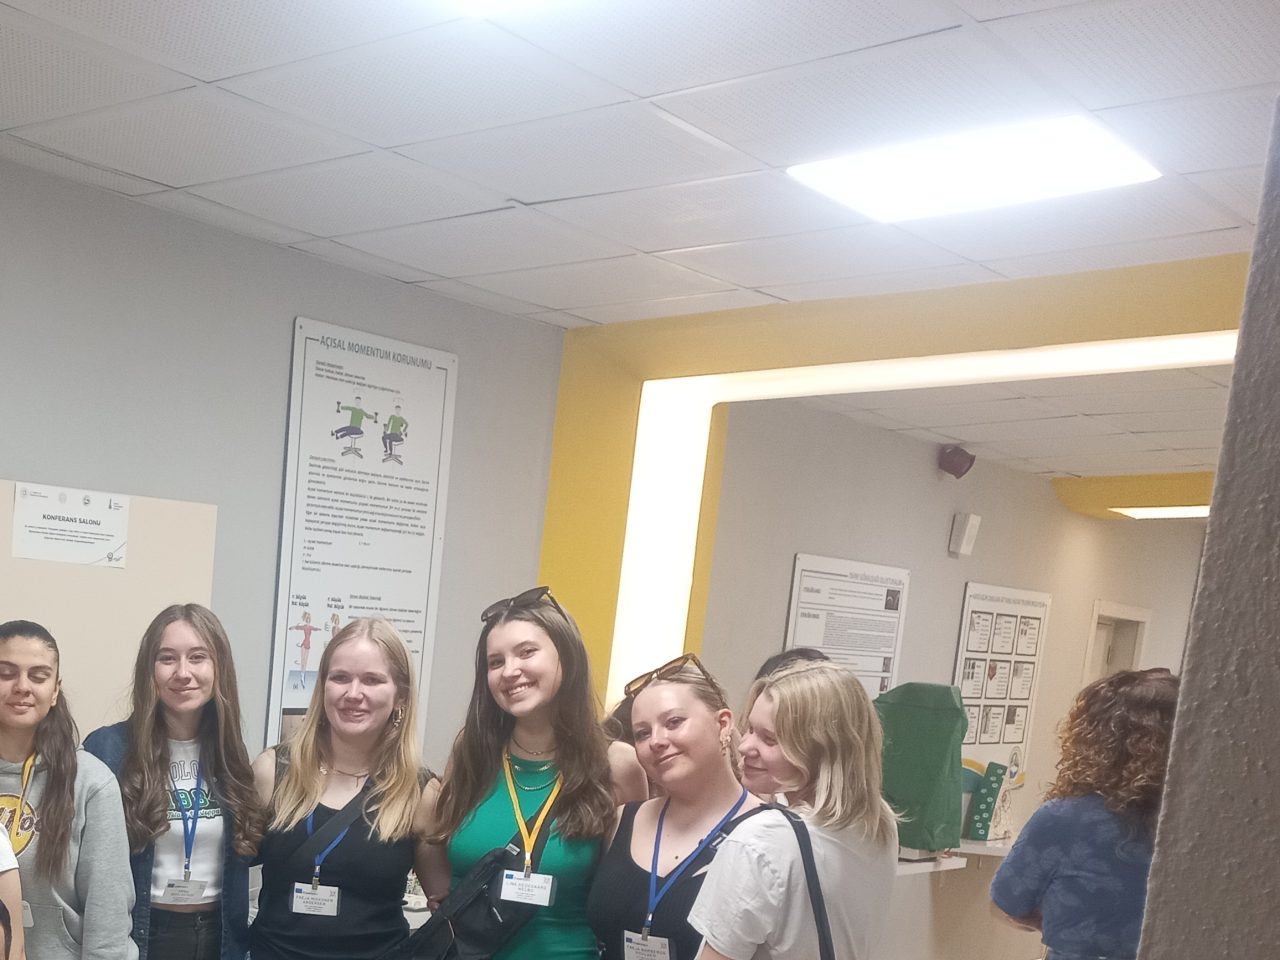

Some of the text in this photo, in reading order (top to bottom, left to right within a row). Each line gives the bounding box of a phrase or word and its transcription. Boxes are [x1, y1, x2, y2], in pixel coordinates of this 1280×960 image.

[320, 335, 433, 370] AÇISAL MOMENTUM KORUNUMU
[42, 514, 101, 526] KONFERANS SALONU
